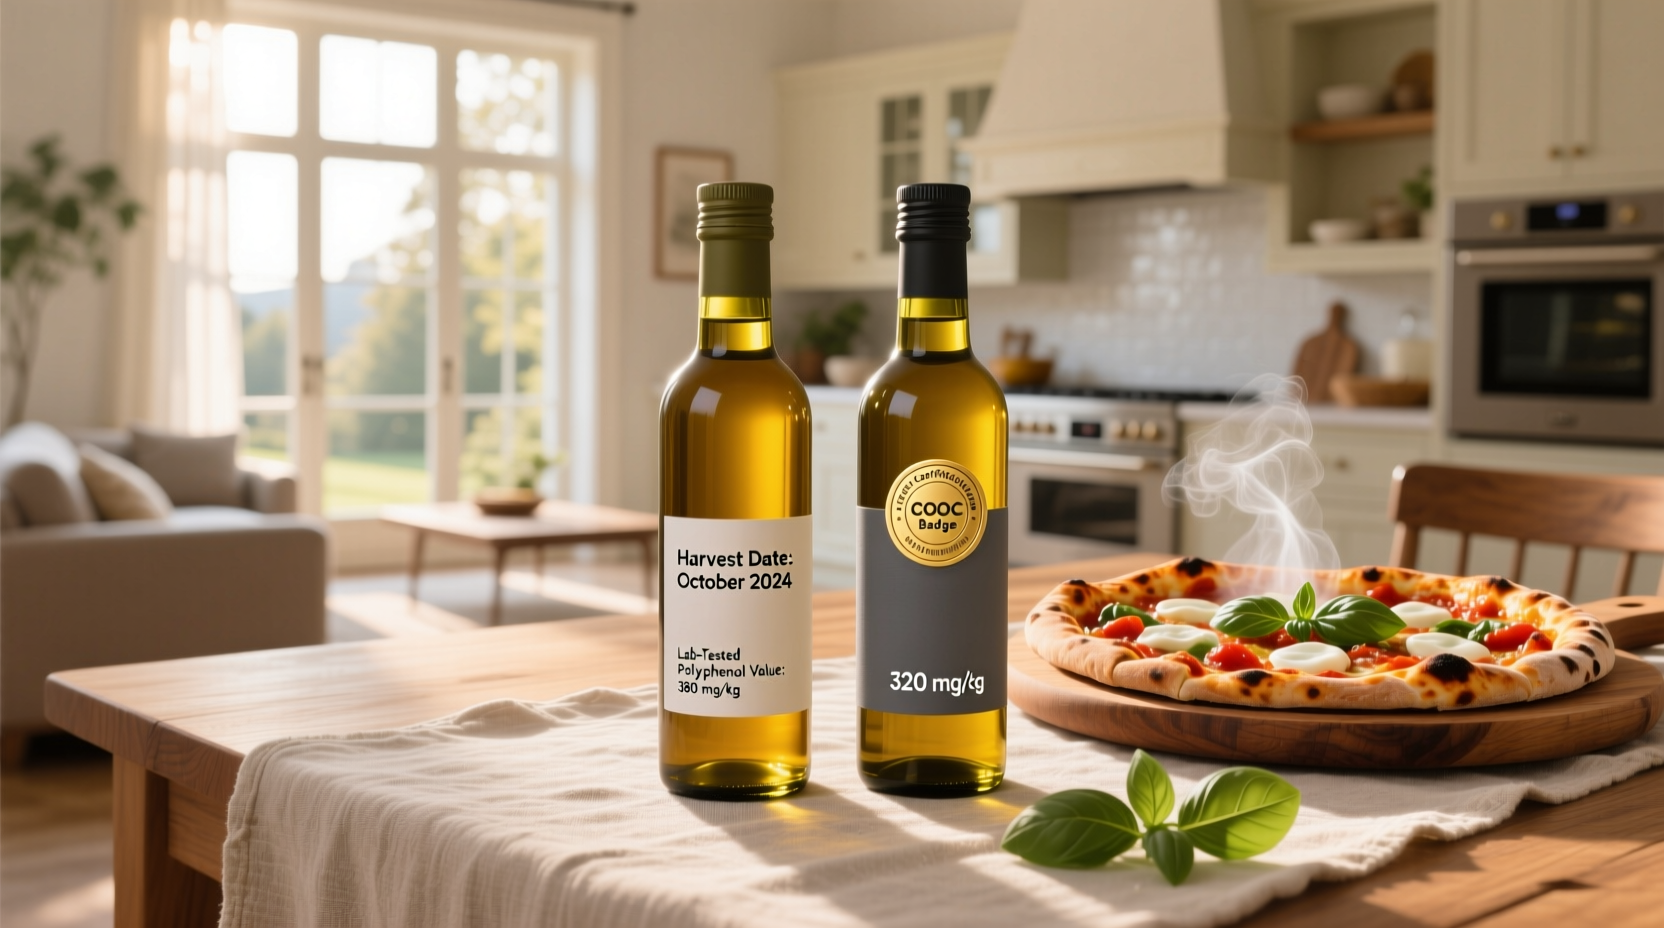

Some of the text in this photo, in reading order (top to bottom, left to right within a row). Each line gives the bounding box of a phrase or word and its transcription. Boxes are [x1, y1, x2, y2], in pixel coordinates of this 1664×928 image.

[911, 502, 963, 516] COOC
[918, 519, 957, 533] Badge
[678, 549, 793, 567] Harvest Date:
[678, 572, 792, 590] October 2024
[678, 647, 741, 661] Lab-Tested
[678, 664, 785, 681] Polyphenol Value:
[889, 671, 927, 692] 320
[702, 682, 741, 699] mg/kg
